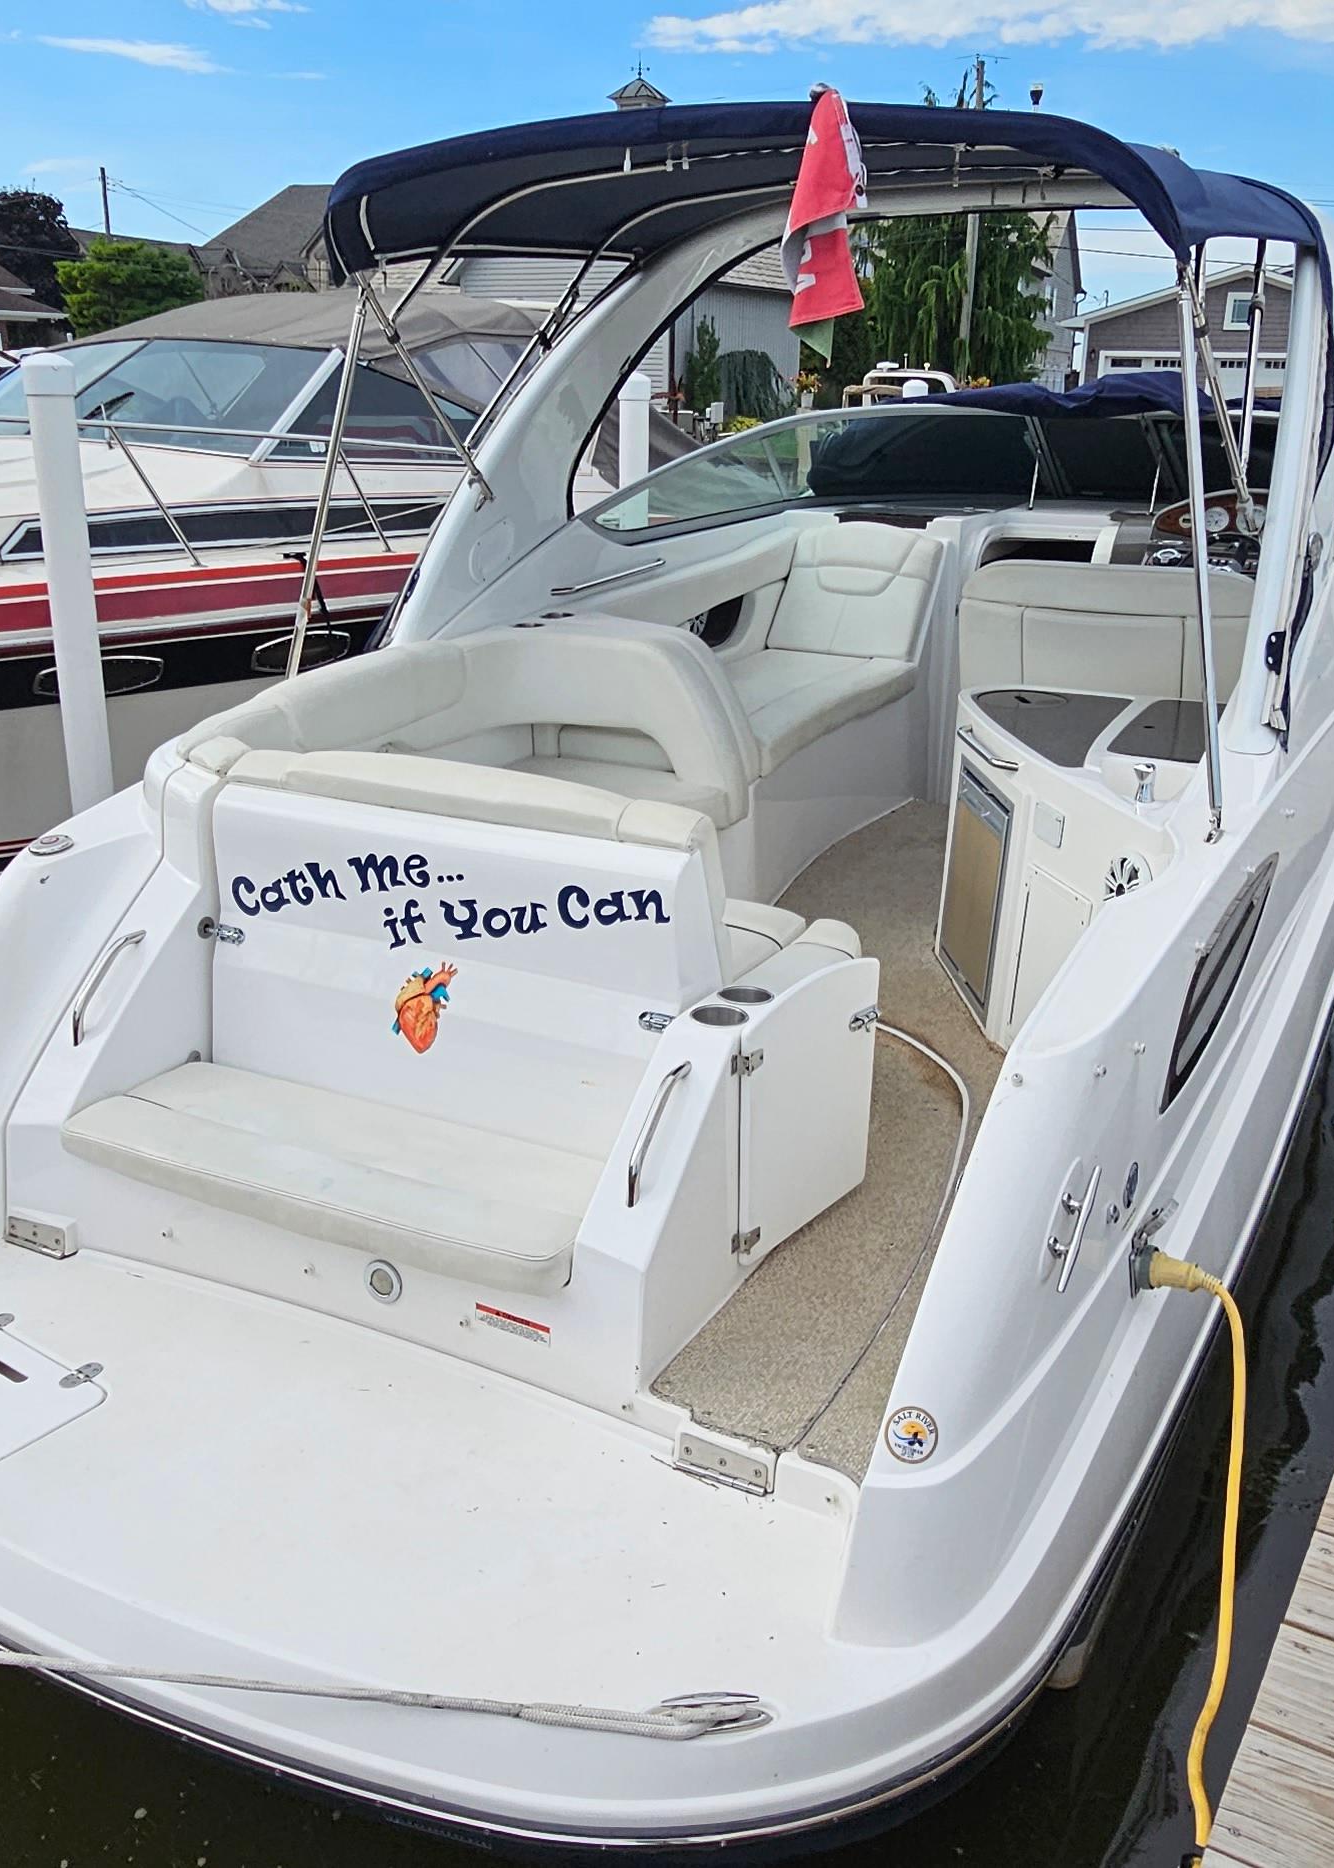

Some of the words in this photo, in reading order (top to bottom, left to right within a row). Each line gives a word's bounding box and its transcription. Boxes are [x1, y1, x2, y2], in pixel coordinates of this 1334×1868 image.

[231, 862, 348, 917] Cath
[383, 899, 427, 950] if
[440, 899, 548, 941] You
[558, 885, 671, 930] Can
[893, 1411, 913, 1426] SALT
[915, 1413, 936, 1436] RIVER
